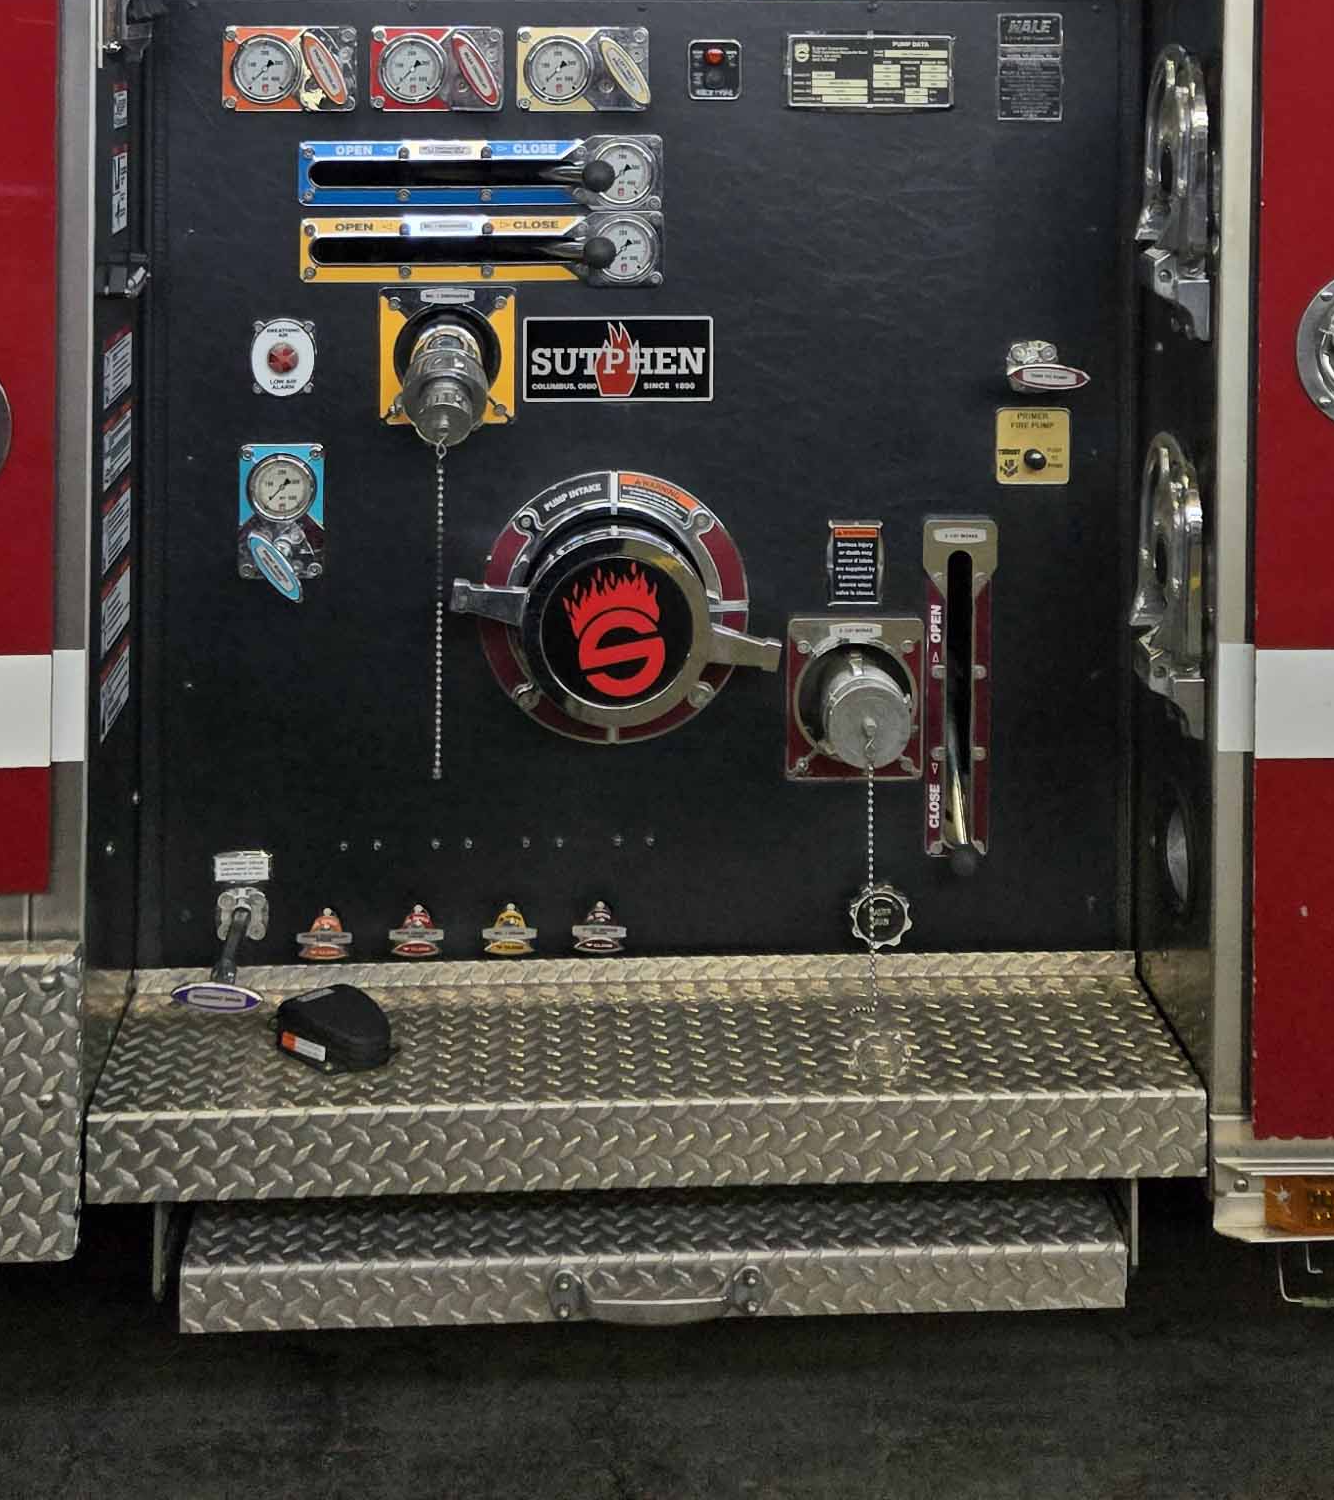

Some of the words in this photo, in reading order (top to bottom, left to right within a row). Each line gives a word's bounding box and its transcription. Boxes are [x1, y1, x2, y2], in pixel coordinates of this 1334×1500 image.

[1008, 20, 1052, 33] HALE
[336, 144, 372, 156] OPEN
[513, 143, 557, 154] CLOSE
[335, 221, 374, 232] OPEN
[513, 220, 559, 230] CLOSE
[531, 347, 706, 376] SUTPHEN
[643, 382, 670, 390] SINCE
[1017, 412, 1050, 420] PRIMER
[643, 480, 681, 500] WARNING
[543, 493, 569, 512] PUMP
[568, 483, 602, 499] INTAKE
[930, 604, 942, 644] OPEN
[929, 783, 941, 829] CLOSE
